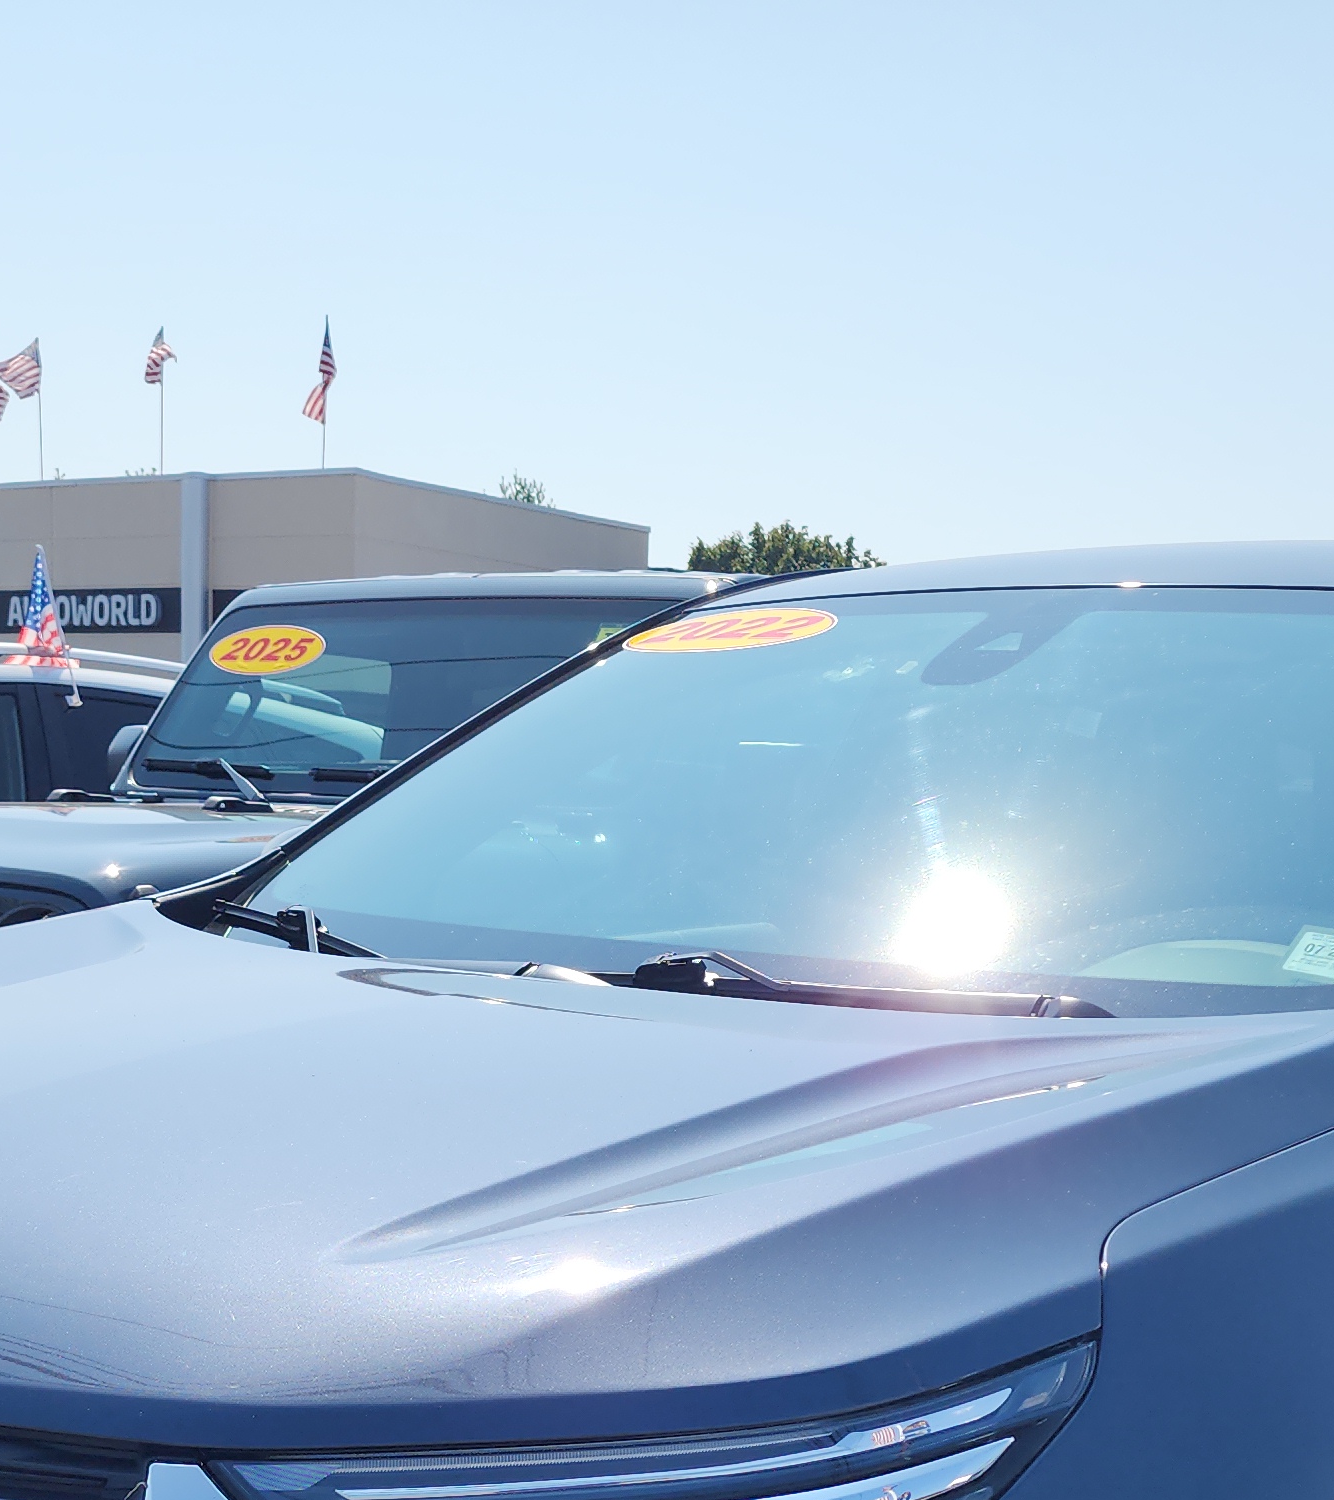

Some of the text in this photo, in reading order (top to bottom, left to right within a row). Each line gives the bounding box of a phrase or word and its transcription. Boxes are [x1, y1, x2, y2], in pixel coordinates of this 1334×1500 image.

[7, 594, 158, 626] AOWORLD
[637, 616, 826, 645] 2022
[219, 637, 315, 662] 2025
[1304, 943, 1326, 954] 07
